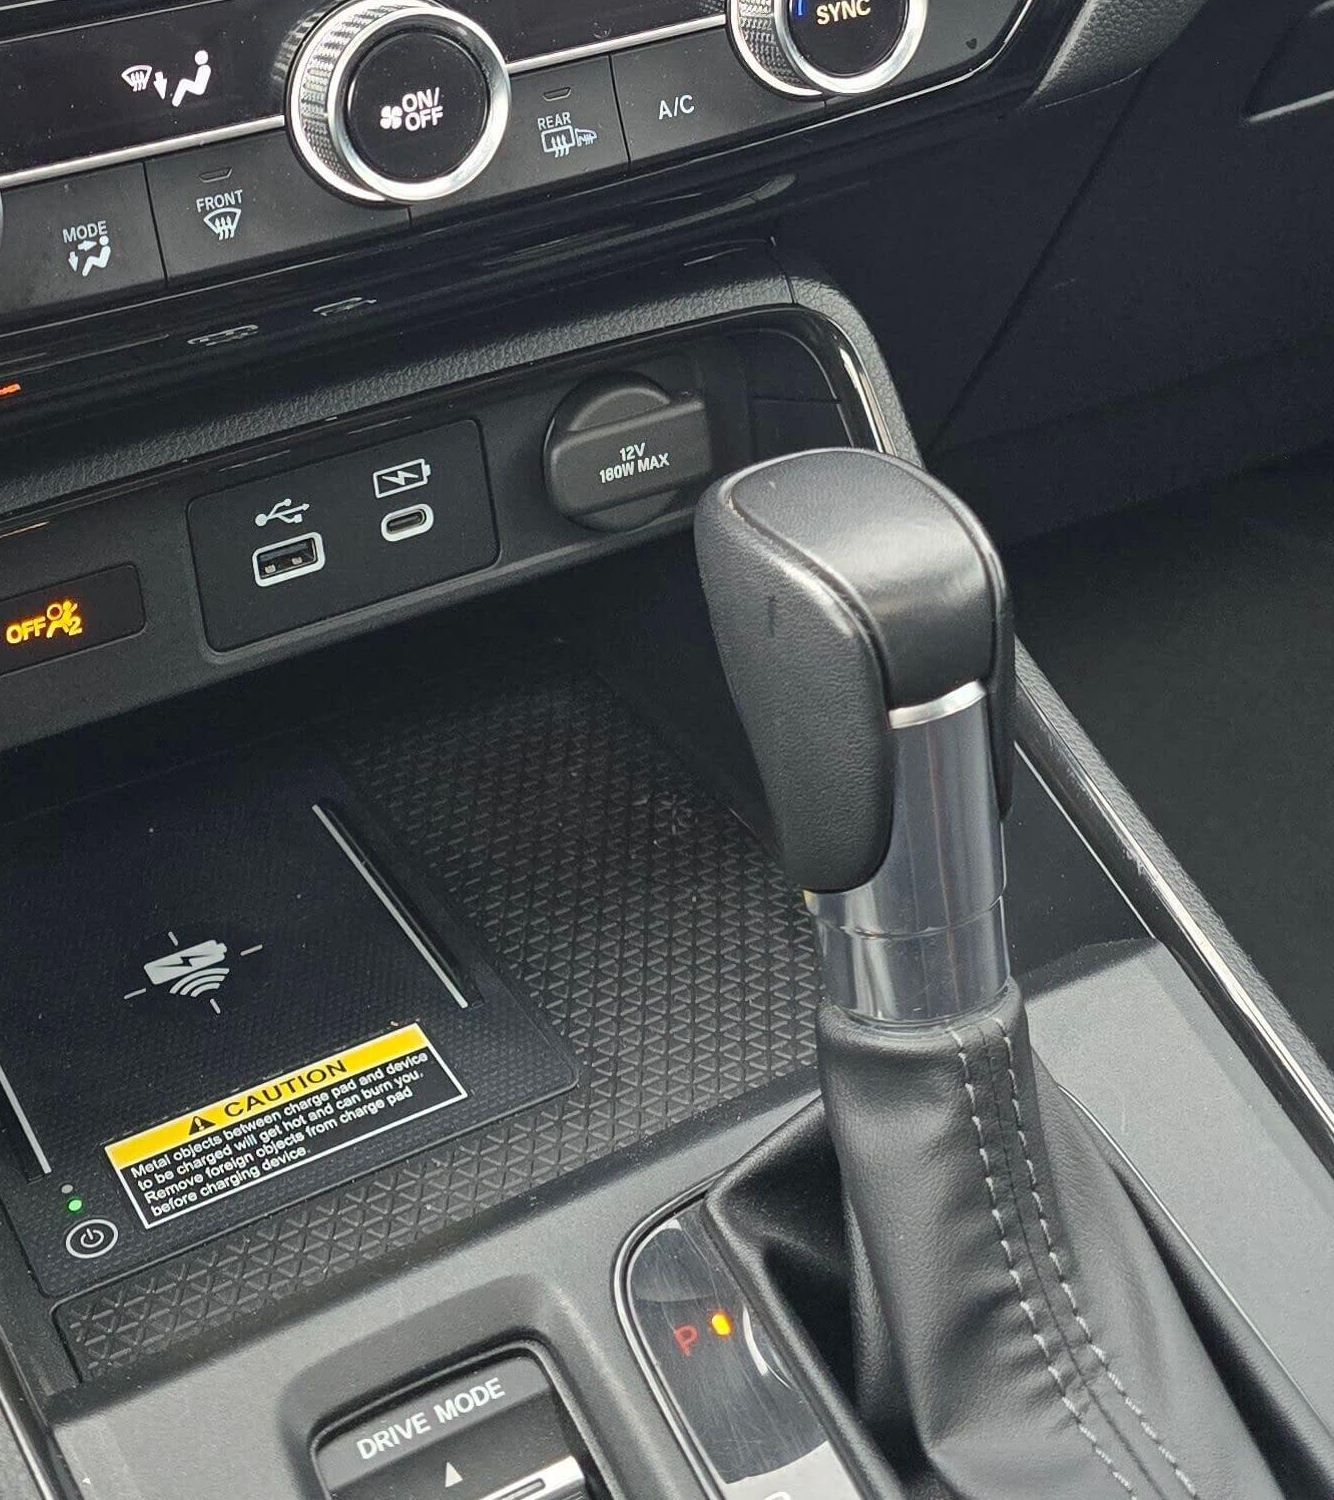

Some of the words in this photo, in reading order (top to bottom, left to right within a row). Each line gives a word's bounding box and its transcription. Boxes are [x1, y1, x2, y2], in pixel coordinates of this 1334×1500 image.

[402, 86, 442, 113] ON/
[657, 93, 696, 120] A/C
[404, 104, 444, 132] OFF
[537, 111, 572, 130] REAR
[196, 189, 243, 212] FRONT
[63, 221, 108, 243] MODE
[620, 442, 646, 461] 12V
[599, 460, 634, 483] 180W
[637, 453, 669, 473] MAX
[5, 615, 47, 645] OFF
[224, 1059, 348, 1117] CAUTION
[130, 1155, 171, 1178] Metal
[173, 1135, 222, 1161] objects
[223, 1110, 281, 1141] between
[283, 1091, 330, 1116] charge
[331, 1080, 357, 1098] pad
[359, 1068, 385, 1086] and
[386, 1052, 428, 1074] device
[137, 1180, 153, 1191] to
[156, 1170, 174, 1184] be
[176, 1145, 233, 1175] charged
[233, 1135, 258, 1151] will
[260, 1125, 283, 1143] get
[284, 1114, 309, 1132] hot
[309, 1104, 335, 1121] and
[336, 1093, 361, 1110] can
[361, 1082, 394, 1102] burn
[394, 1072, 424, 1091] you.
[144, 1172, 204, 1204] Remove
[205, 1152, 254, 1179] foreign
[256, 1131, 305, 1158] objects
[305, 1119, 338, 1139] from
[339, 1099, 386, 1124] charge
[387, 1087, 413, 1107] pad
[151, 1193, 198, 1217] before
[200, 1165, 261, 1196] charging
[672, 1323, 699, 1357] P
[356, 1413, 430, 1459] DRIVE
[433, 1378, 505, 1423] MODE
